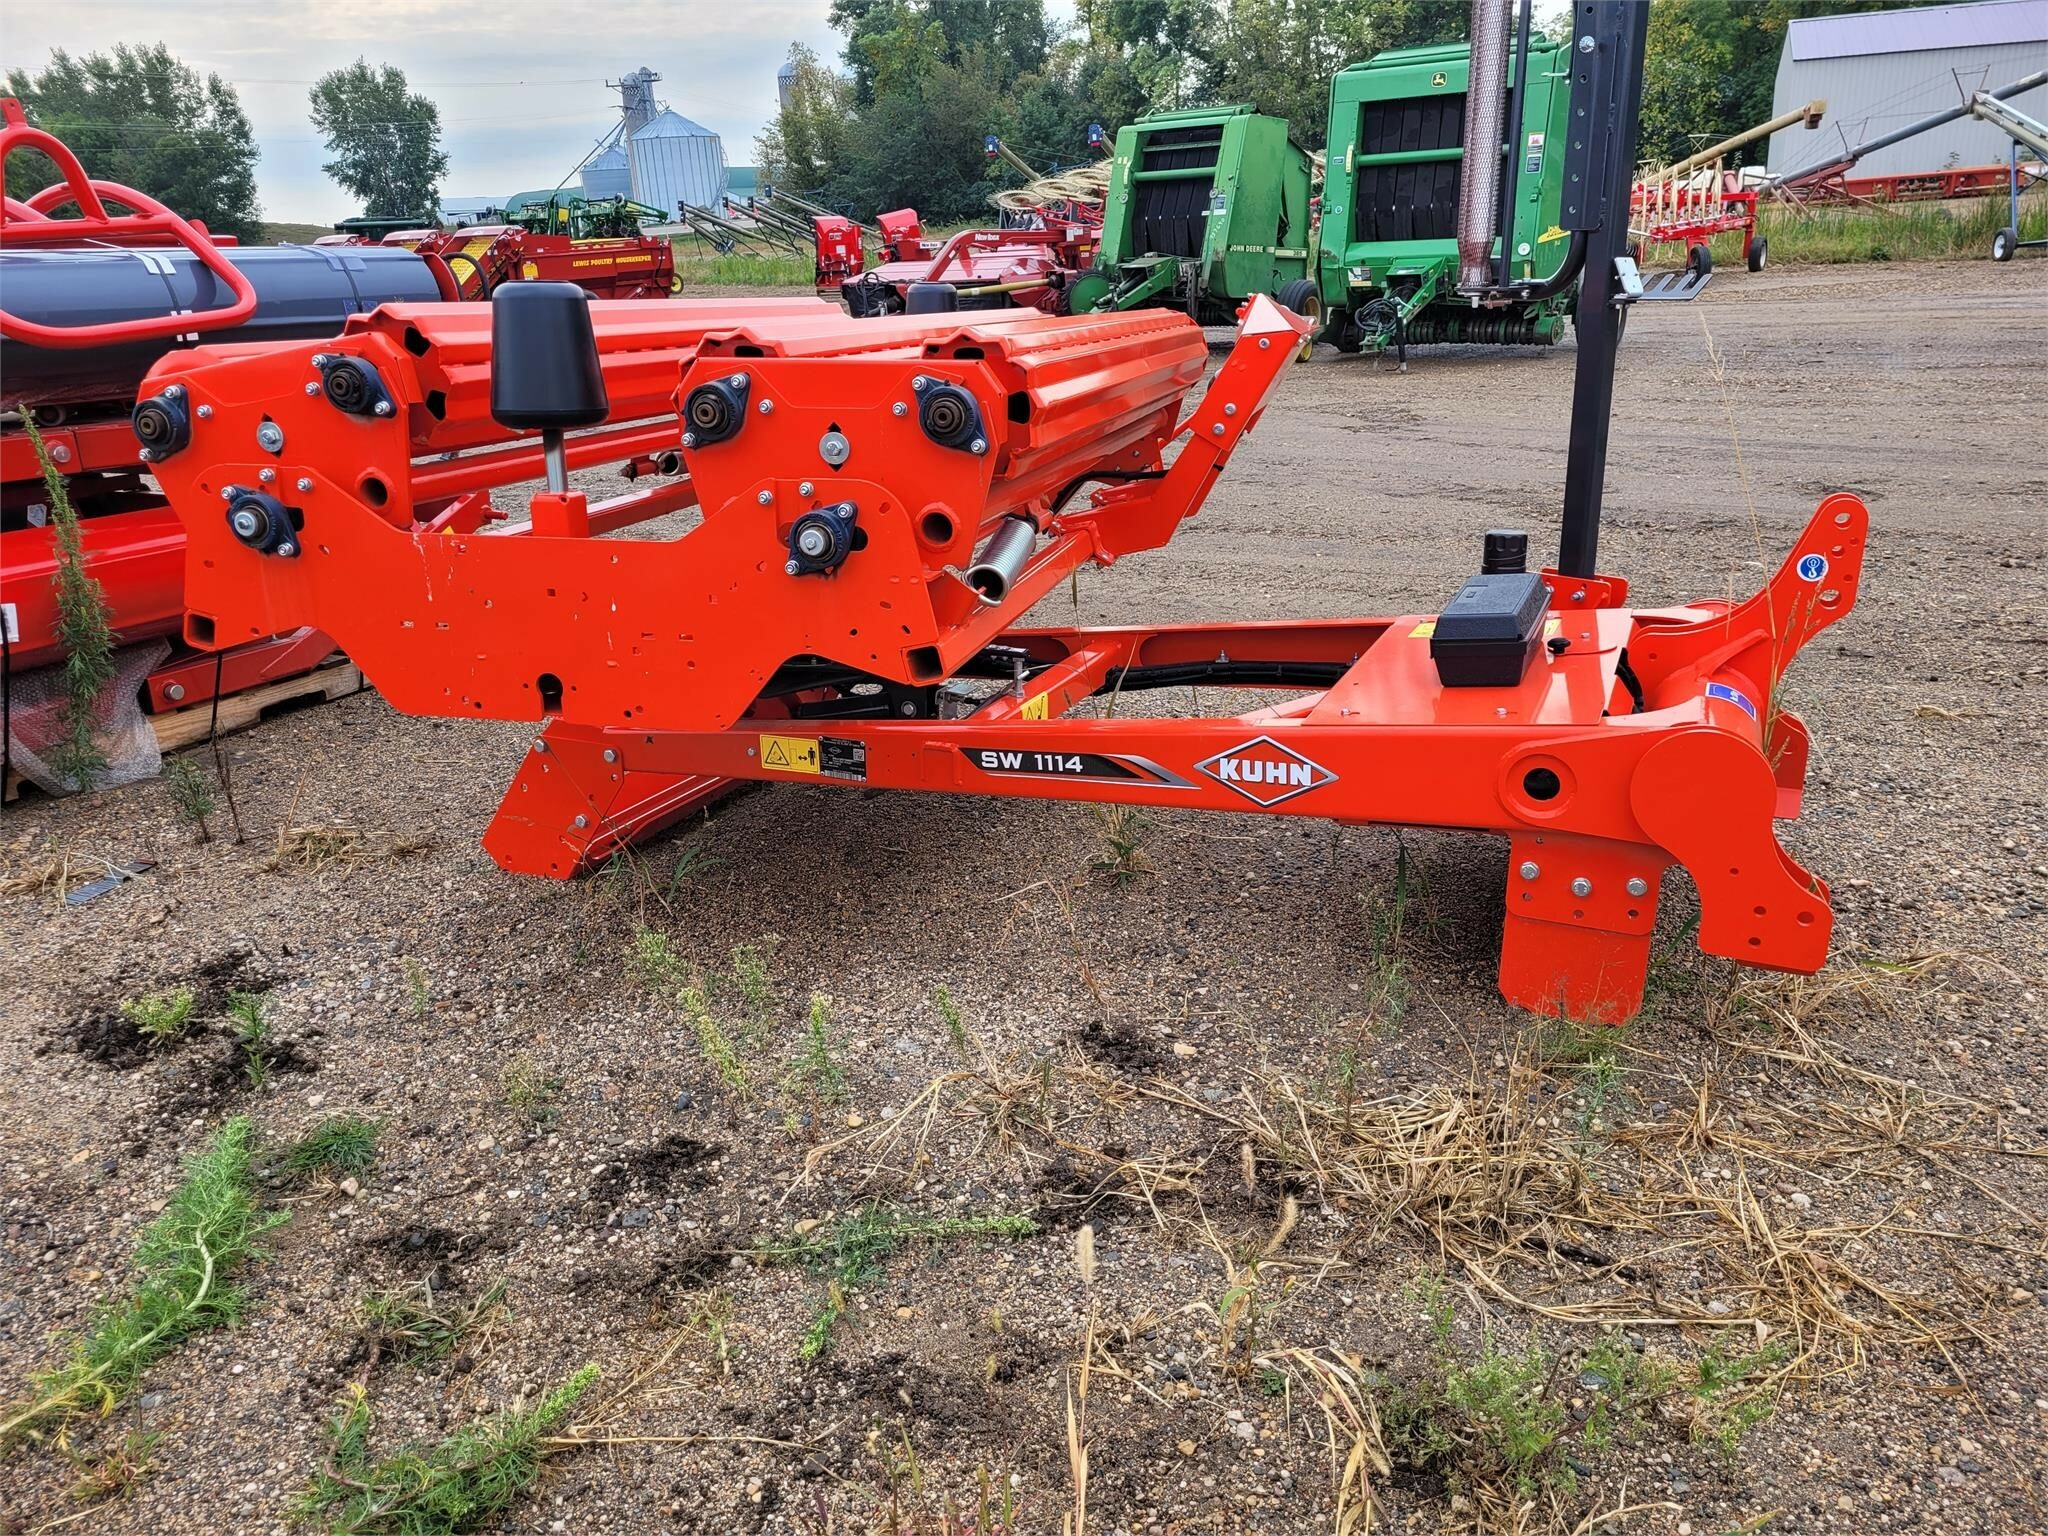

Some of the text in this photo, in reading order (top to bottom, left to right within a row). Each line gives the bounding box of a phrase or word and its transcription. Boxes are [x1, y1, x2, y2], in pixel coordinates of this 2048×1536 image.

[975, 233, 986, 241] New
[1246, 245, 1264, 253] DEERE
[573, 259, 589, 267] LEWIS
[591, 258, 613, 266] POULTRY
[981, 751, 1084, 773] SW 1114
[1219, 757, 1312, 787] KUHN
